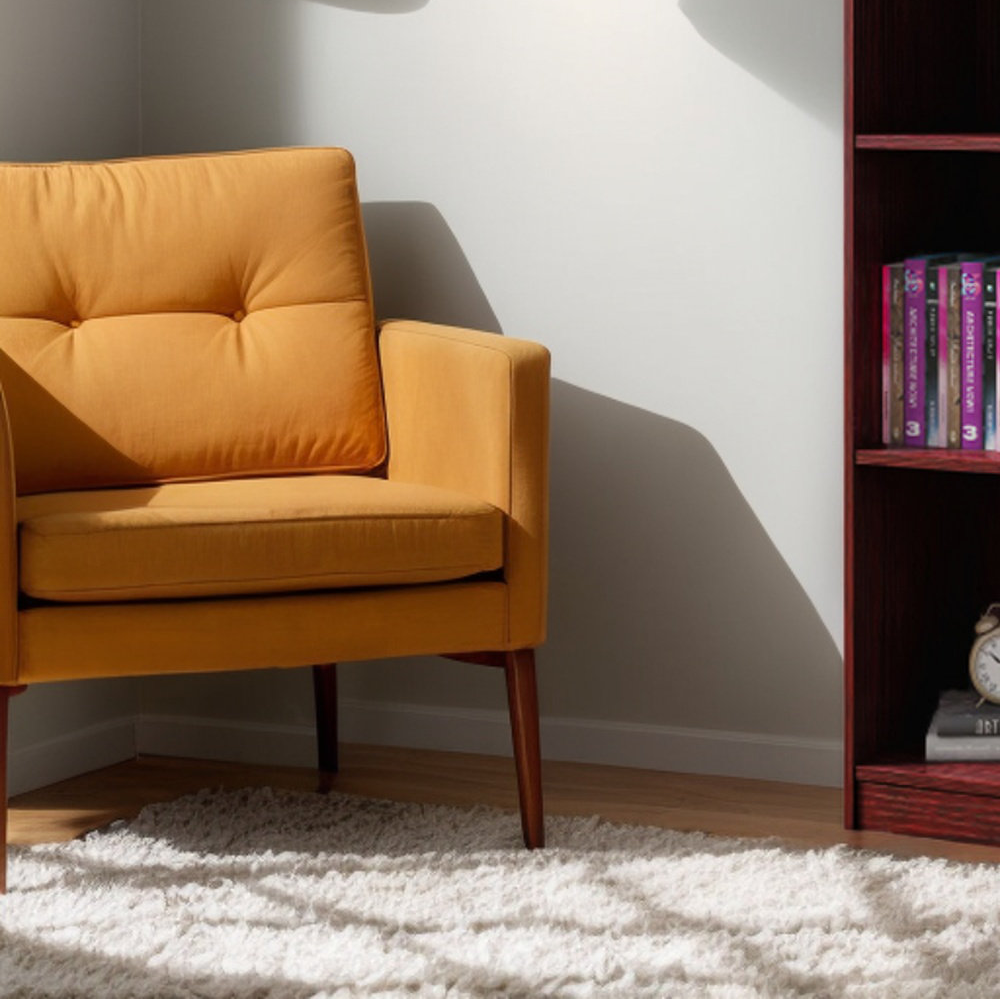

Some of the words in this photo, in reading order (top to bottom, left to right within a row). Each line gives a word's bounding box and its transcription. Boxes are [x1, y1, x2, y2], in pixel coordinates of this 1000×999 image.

[905, 421, 921, 436] 3
[962, 425, 978, 441] 3
[976, 719, 999, 734] ART
